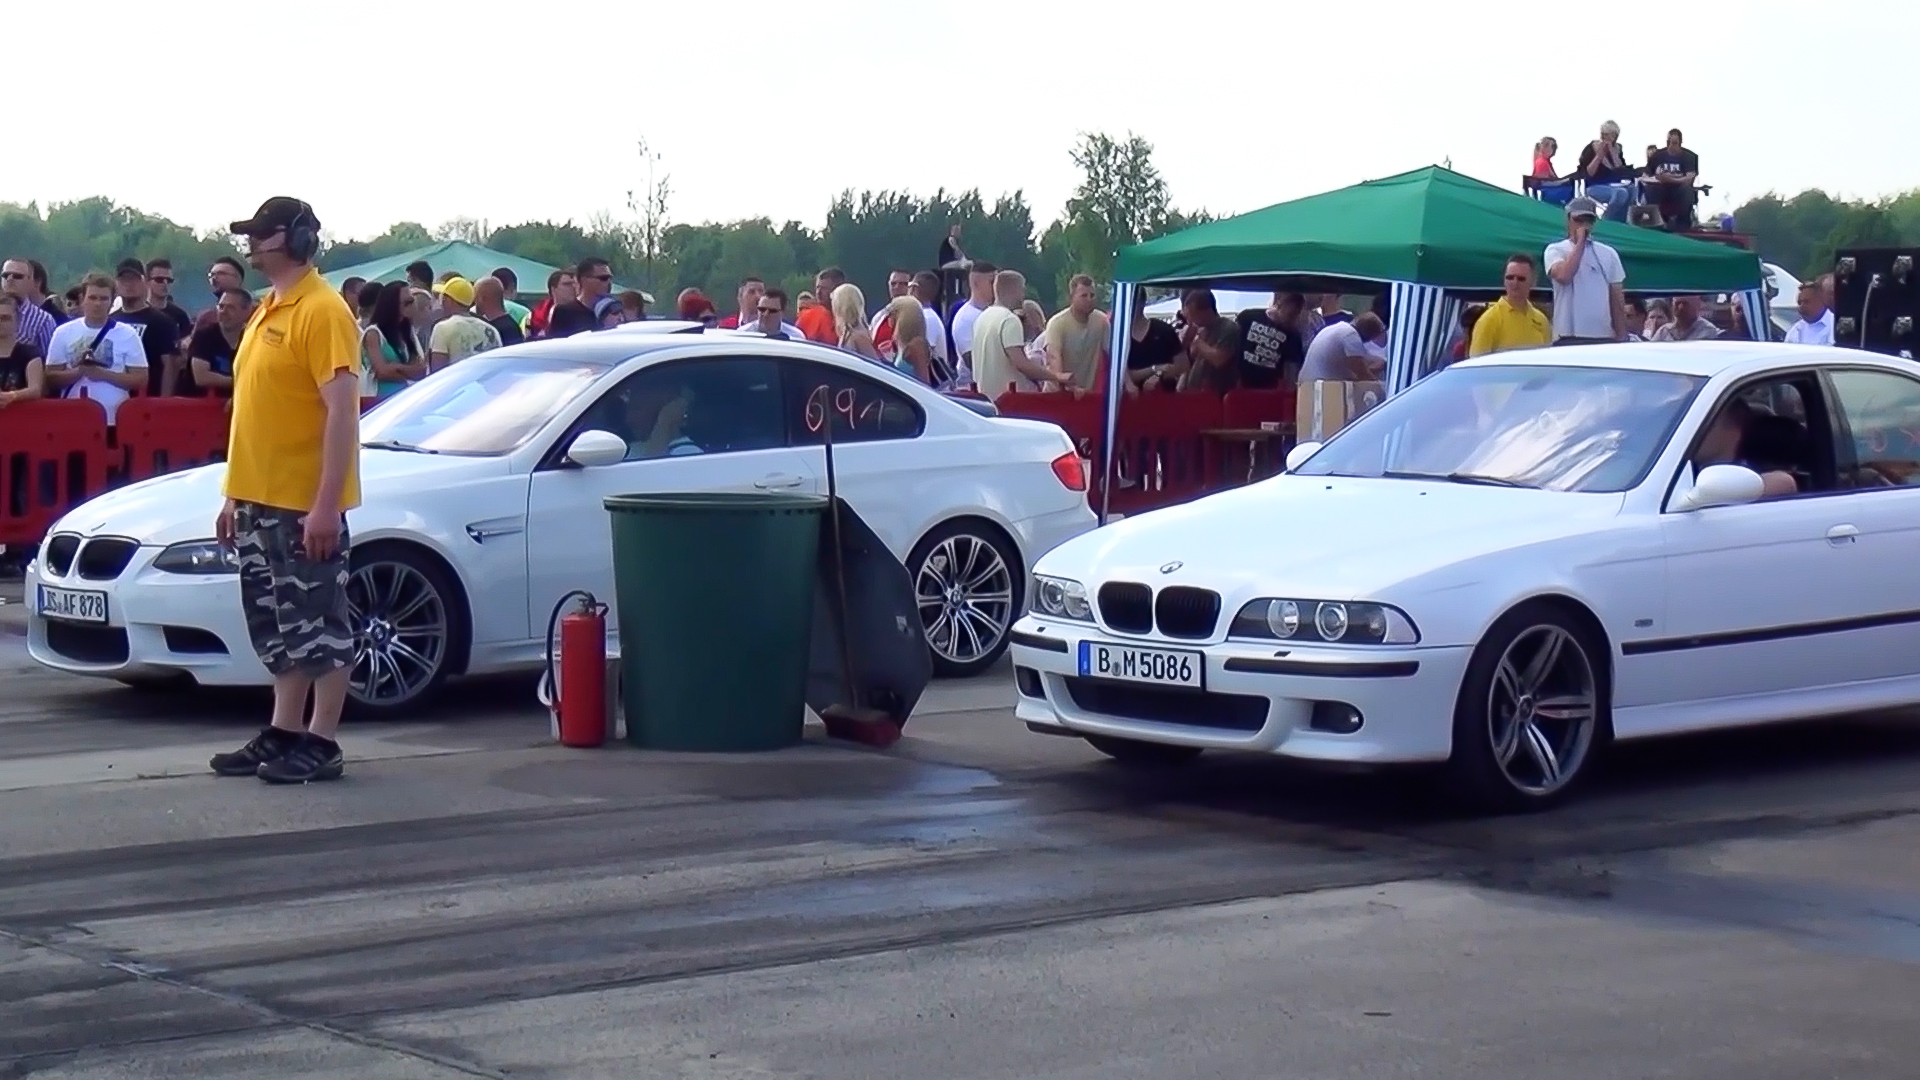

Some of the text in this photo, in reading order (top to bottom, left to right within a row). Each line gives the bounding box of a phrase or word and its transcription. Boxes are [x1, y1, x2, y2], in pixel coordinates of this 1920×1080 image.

[63, 594, 76, 615] AF
[79, 594, 103, 618] 878
[1098, 647, 1111, 673] B
